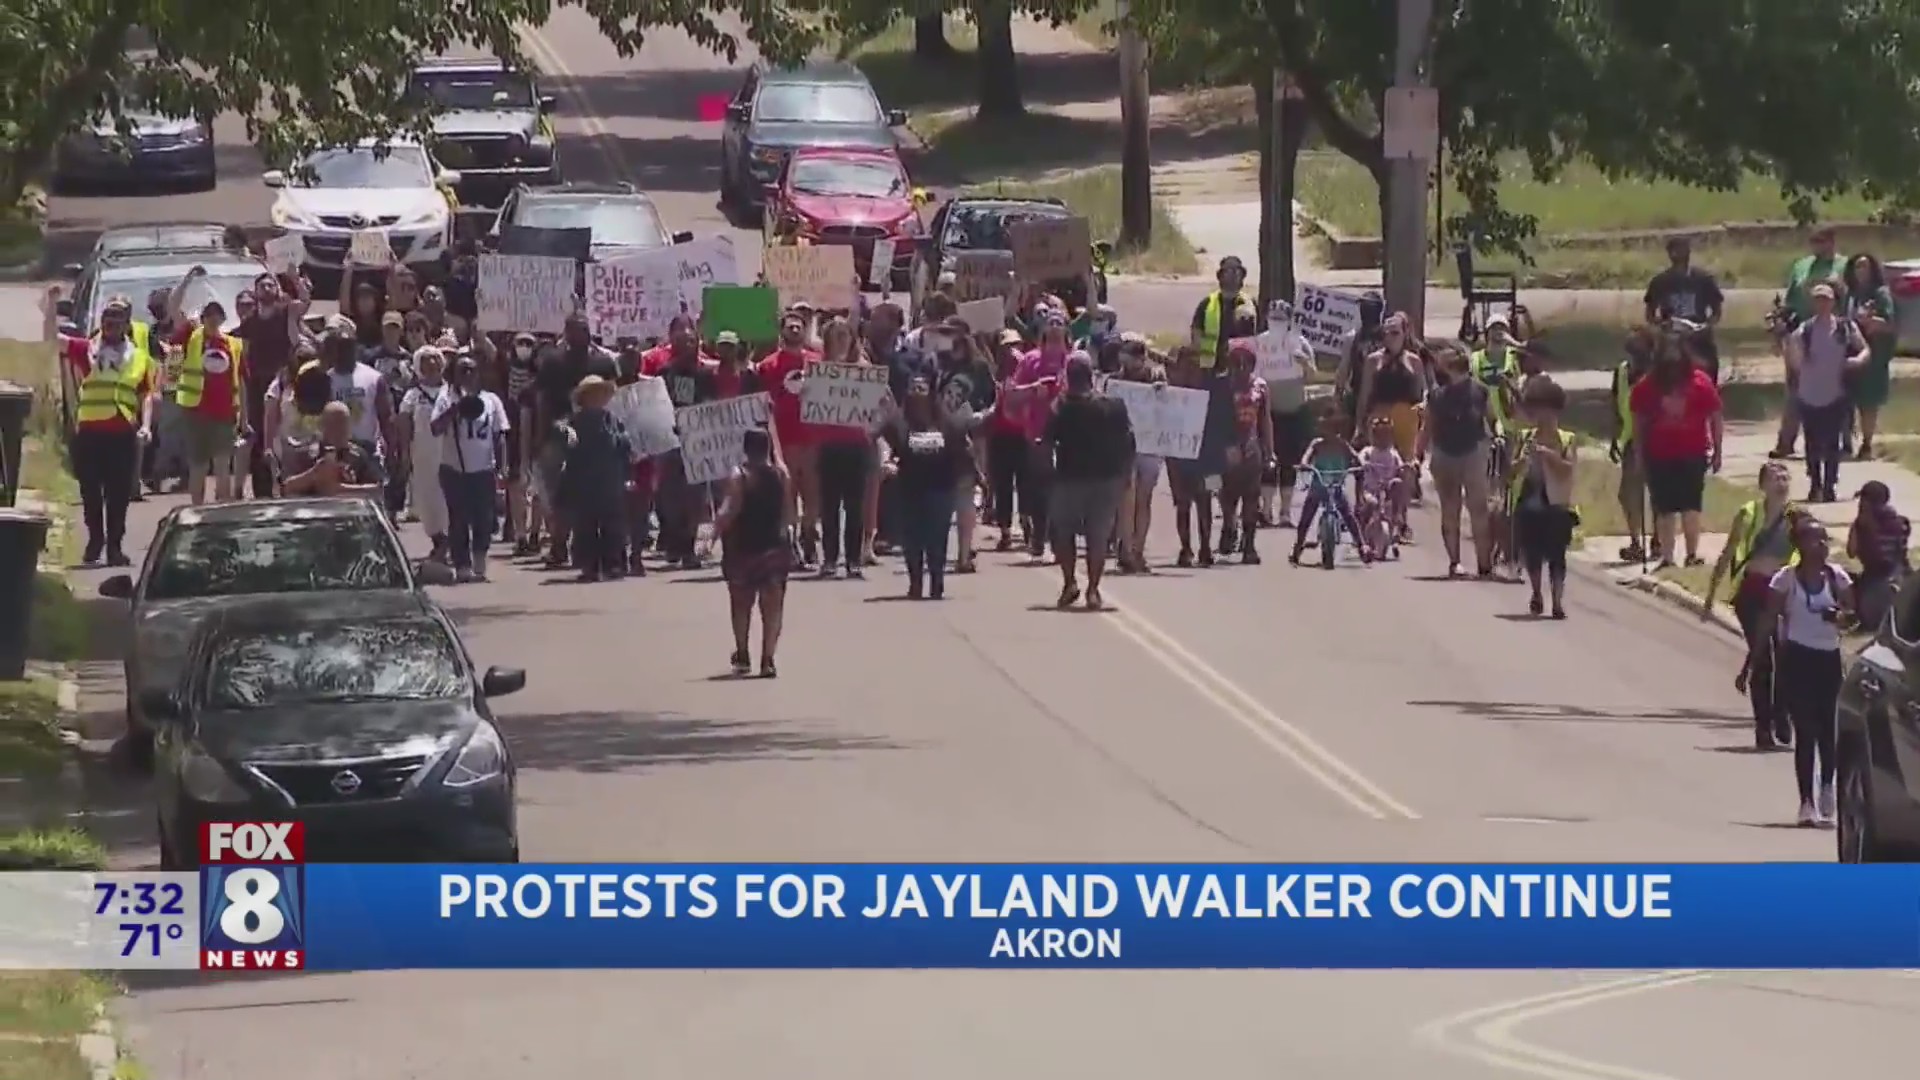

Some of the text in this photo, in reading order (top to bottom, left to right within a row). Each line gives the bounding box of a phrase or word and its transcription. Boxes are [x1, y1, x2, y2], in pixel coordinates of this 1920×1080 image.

[592, 264, 644, 289] Police
[592, 289, 645, 306] CHIEF
[1303, 295, 1325, 313] 60
[1294, 312, 1317, 329] This
[806, 361, 888, 384] JUSTICE
[828, 385, 861, 399] FOR
[803, 401, 882, 423] JAYLAN
